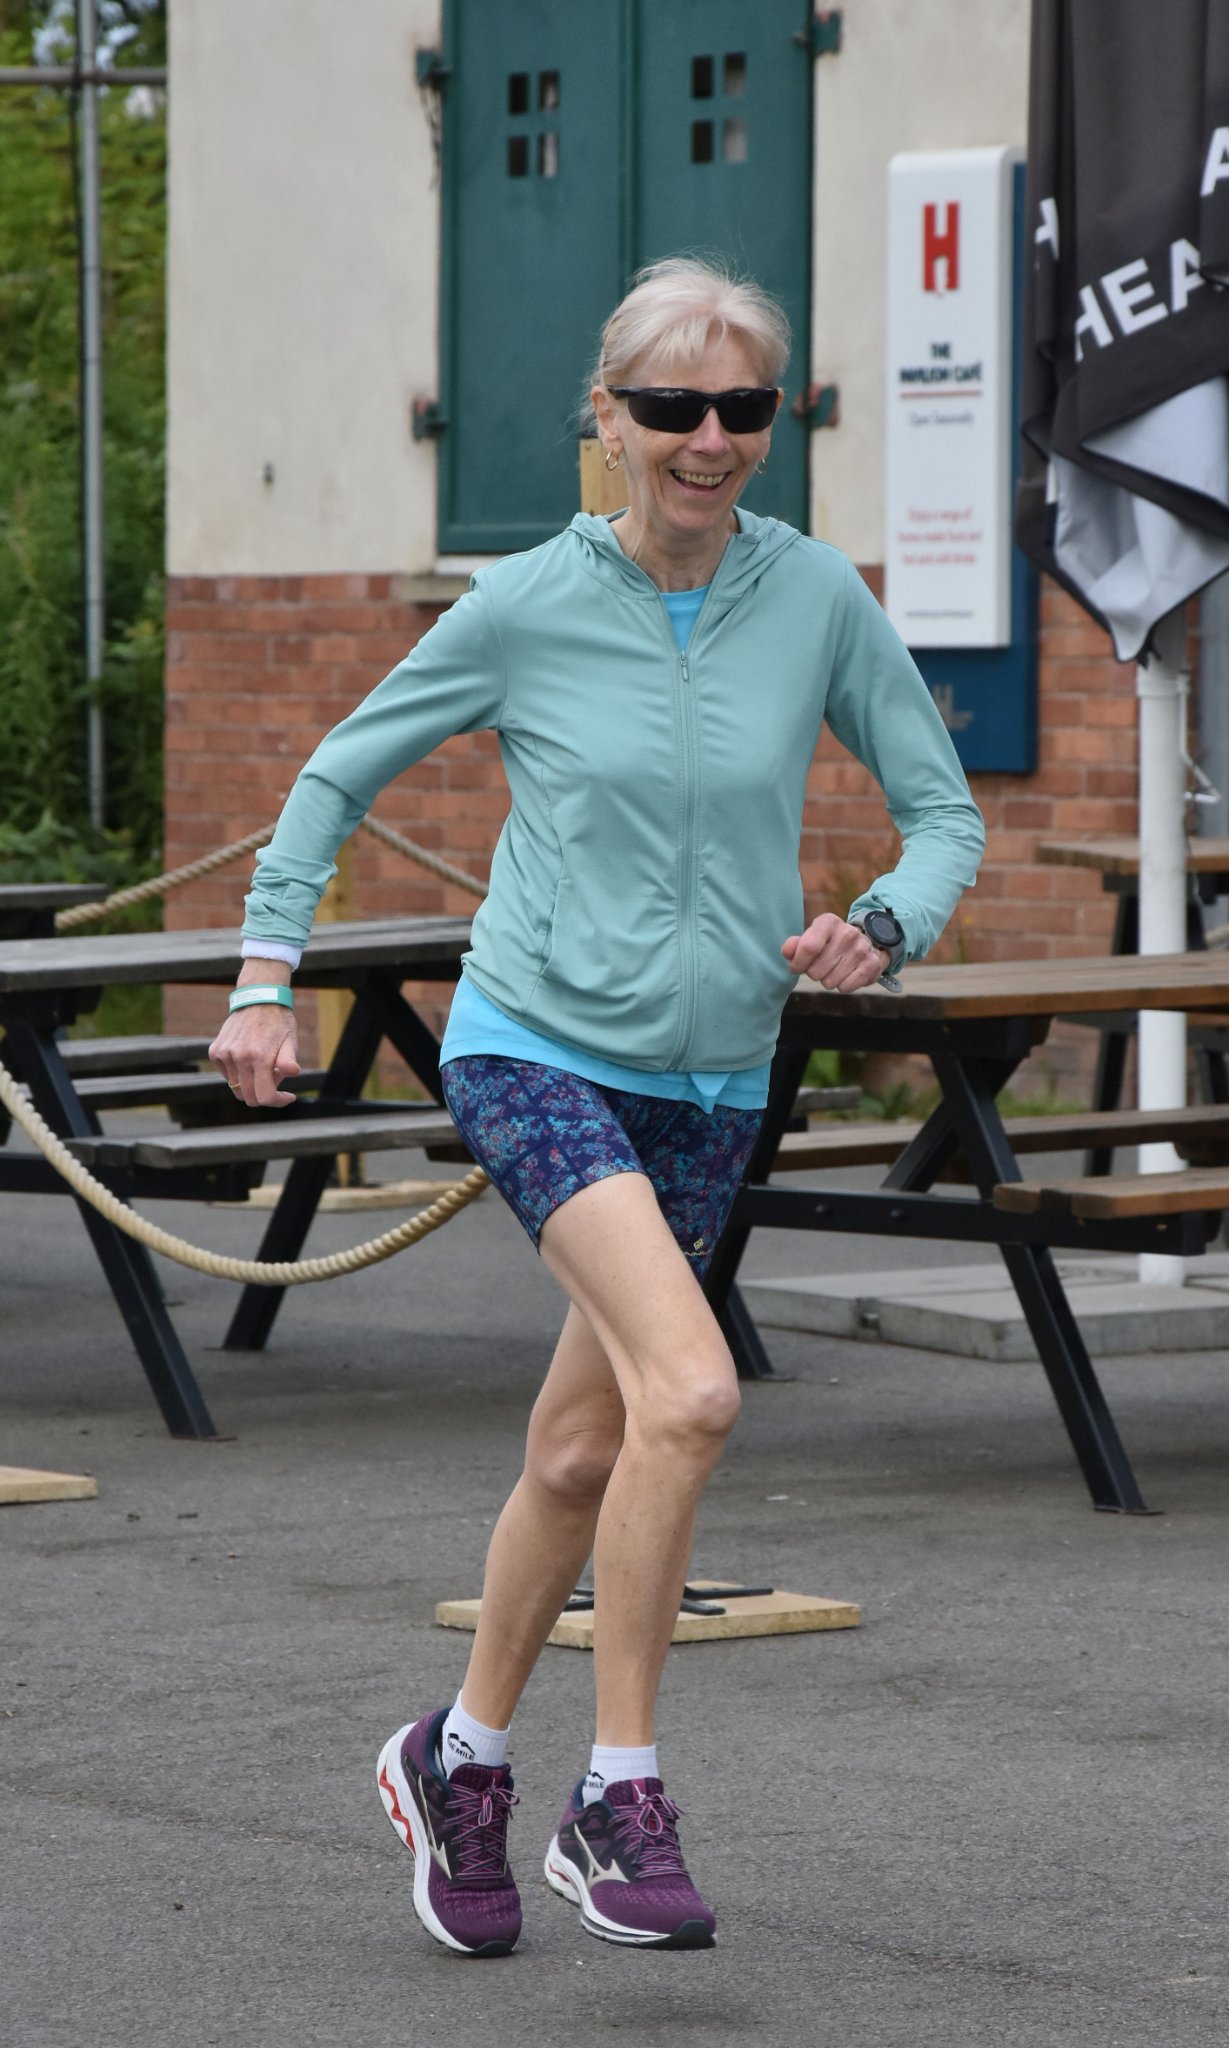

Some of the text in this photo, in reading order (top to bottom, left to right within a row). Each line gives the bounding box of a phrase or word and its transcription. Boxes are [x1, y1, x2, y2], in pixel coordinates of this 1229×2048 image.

[923, 201, 960, 293] H
[930, 343, 952, 359] THE
[455, 1747, 475, 1762] MILE
